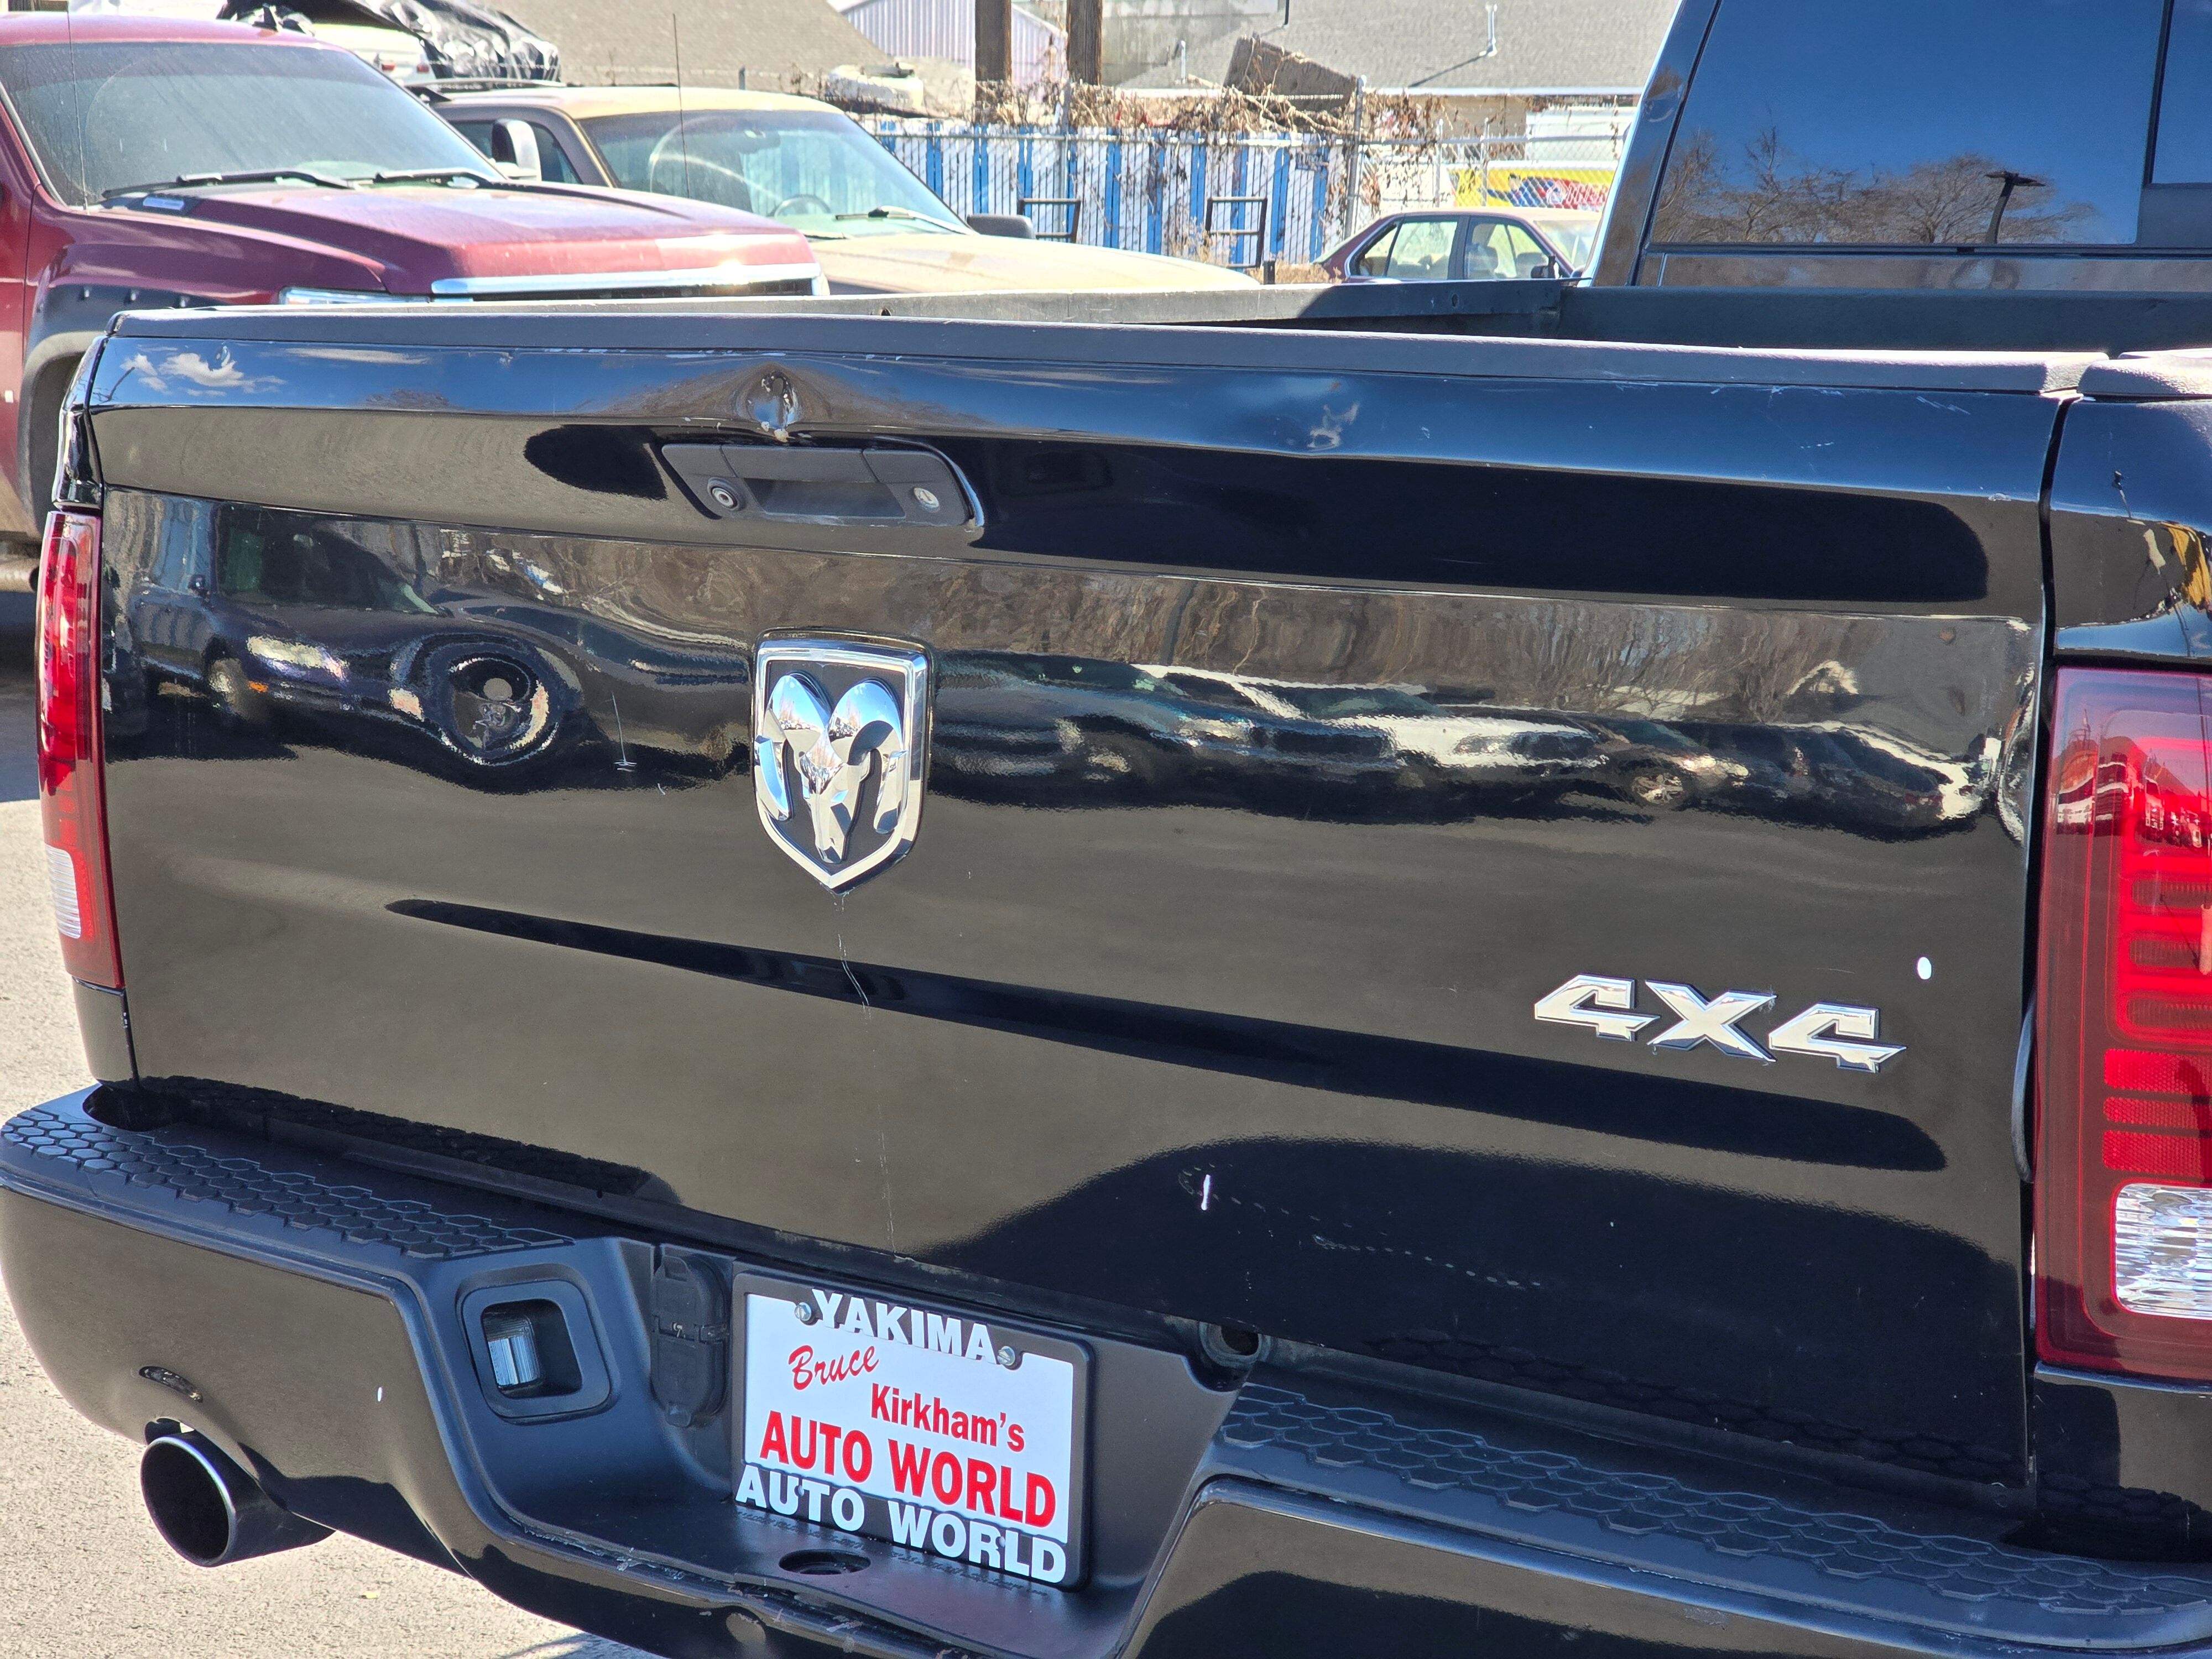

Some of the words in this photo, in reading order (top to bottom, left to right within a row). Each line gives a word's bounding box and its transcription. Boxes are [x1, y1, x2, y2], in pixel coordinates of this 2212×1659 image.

[1535, 973, 1907, 1073] 4X4
[789, 1346, 879, 1390] Bruce
[811, 1288, 1001, 1365] YAKIMA
[872, 1383, 1025, 1452] Kirkham's
[760, 1410, 873, 1483] AUTO
[888, 1438, 1056, 1527] WORLD
[735, 1465, 865, 1531] AUTO
[888, 1501, 1066, 1583] WORLD
